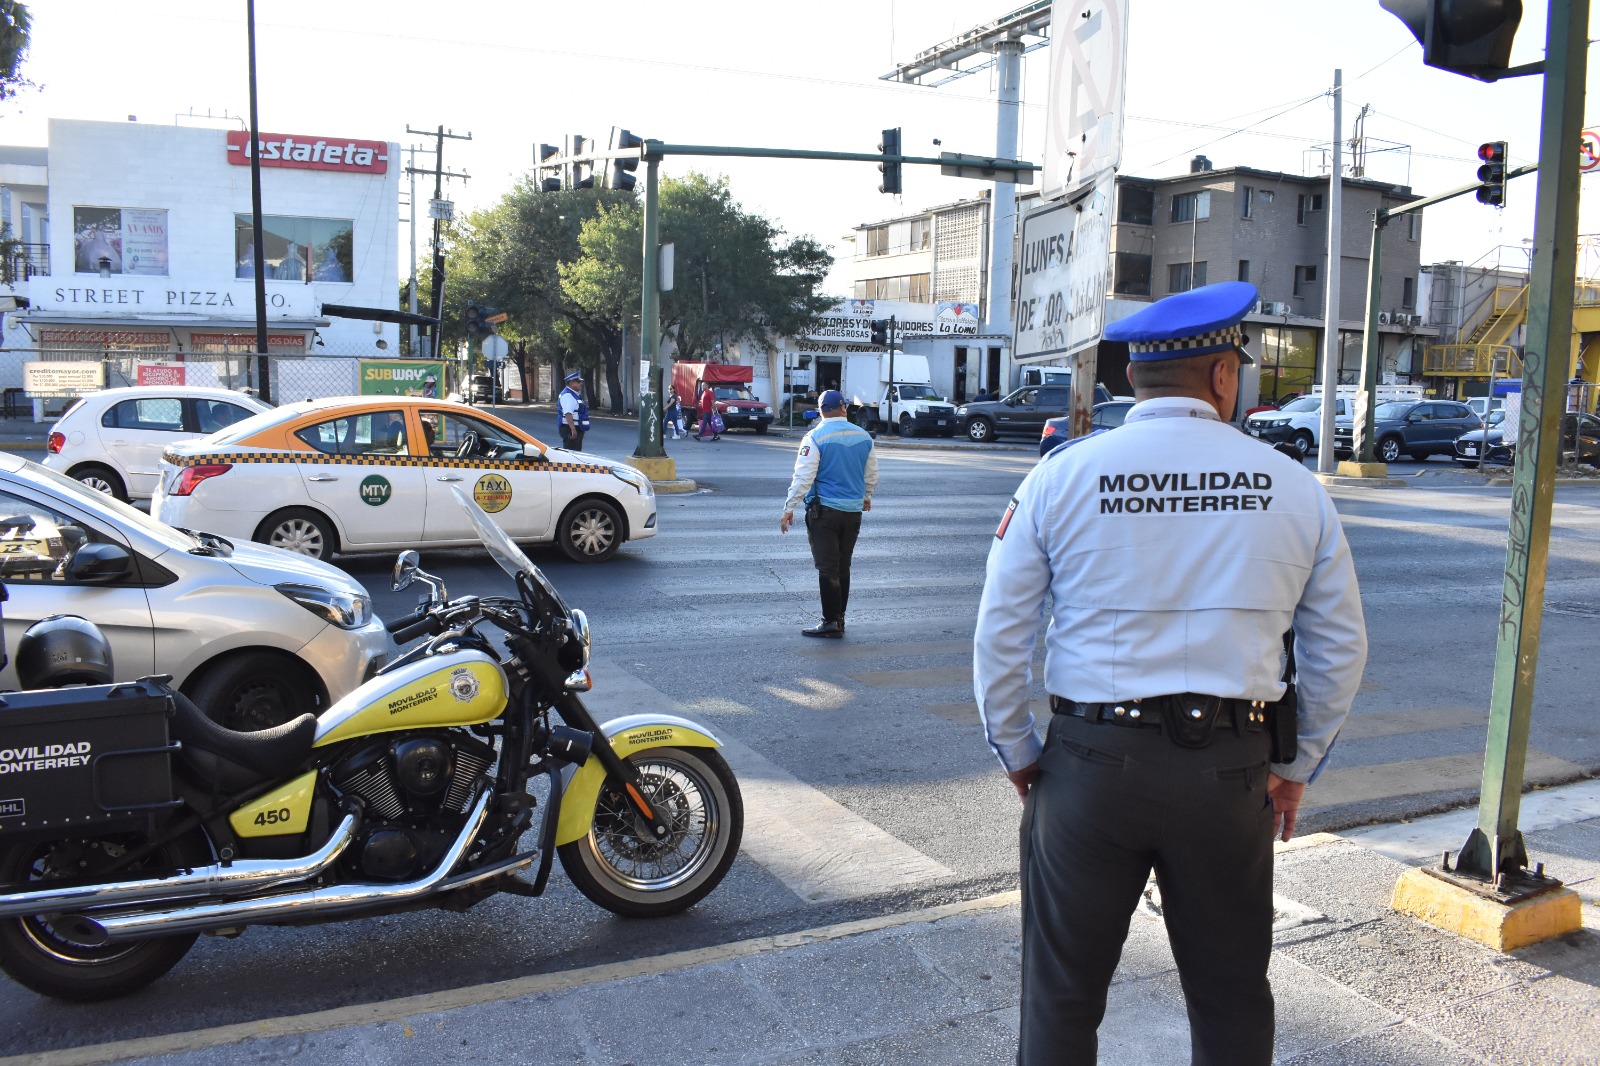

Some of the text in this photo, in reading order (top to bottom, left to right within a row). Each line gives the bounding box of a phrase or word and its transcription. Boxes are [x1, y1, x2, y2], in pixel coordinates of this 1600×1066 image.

[244, 138, 374, 166] estafeta
[1024, 233, 1065, 275] LUNES
[55, 288, 292, 308] STREET PIZZA O.
[1019, 298, 1036, 332] DE
[811, 328, 846, 338] MEJORES
[846, 329, 870, 339] ROSAS
[940, 323, 950, 333] La
[194, 335, 234, 345] ABRIMOS
[235, 336, 259, 345] TODO
[799, 343, 839, 353] 8340-6781
[364, 368, 427, 380] SUBWAY
[362, 484, 388, 496] MTY
[479, 481, 507, 490] TAXI
[1100, 472, 1272, 492] MOVILIDAD
[1100, 495, 1273, 514] MONTERREY
[388, 687, 437, 710] MOVILIDAD
[389, 693, 438, 715] MONTERREY
[628, 728, 673, 740] MOVILIDAD
[628, 734, 673, 745] MONTERREY
[0, 741, 92, 762] OVILIDAD
[0, 754, 92, 774] ONTERREY
[254, 808, 290, 826] 450
